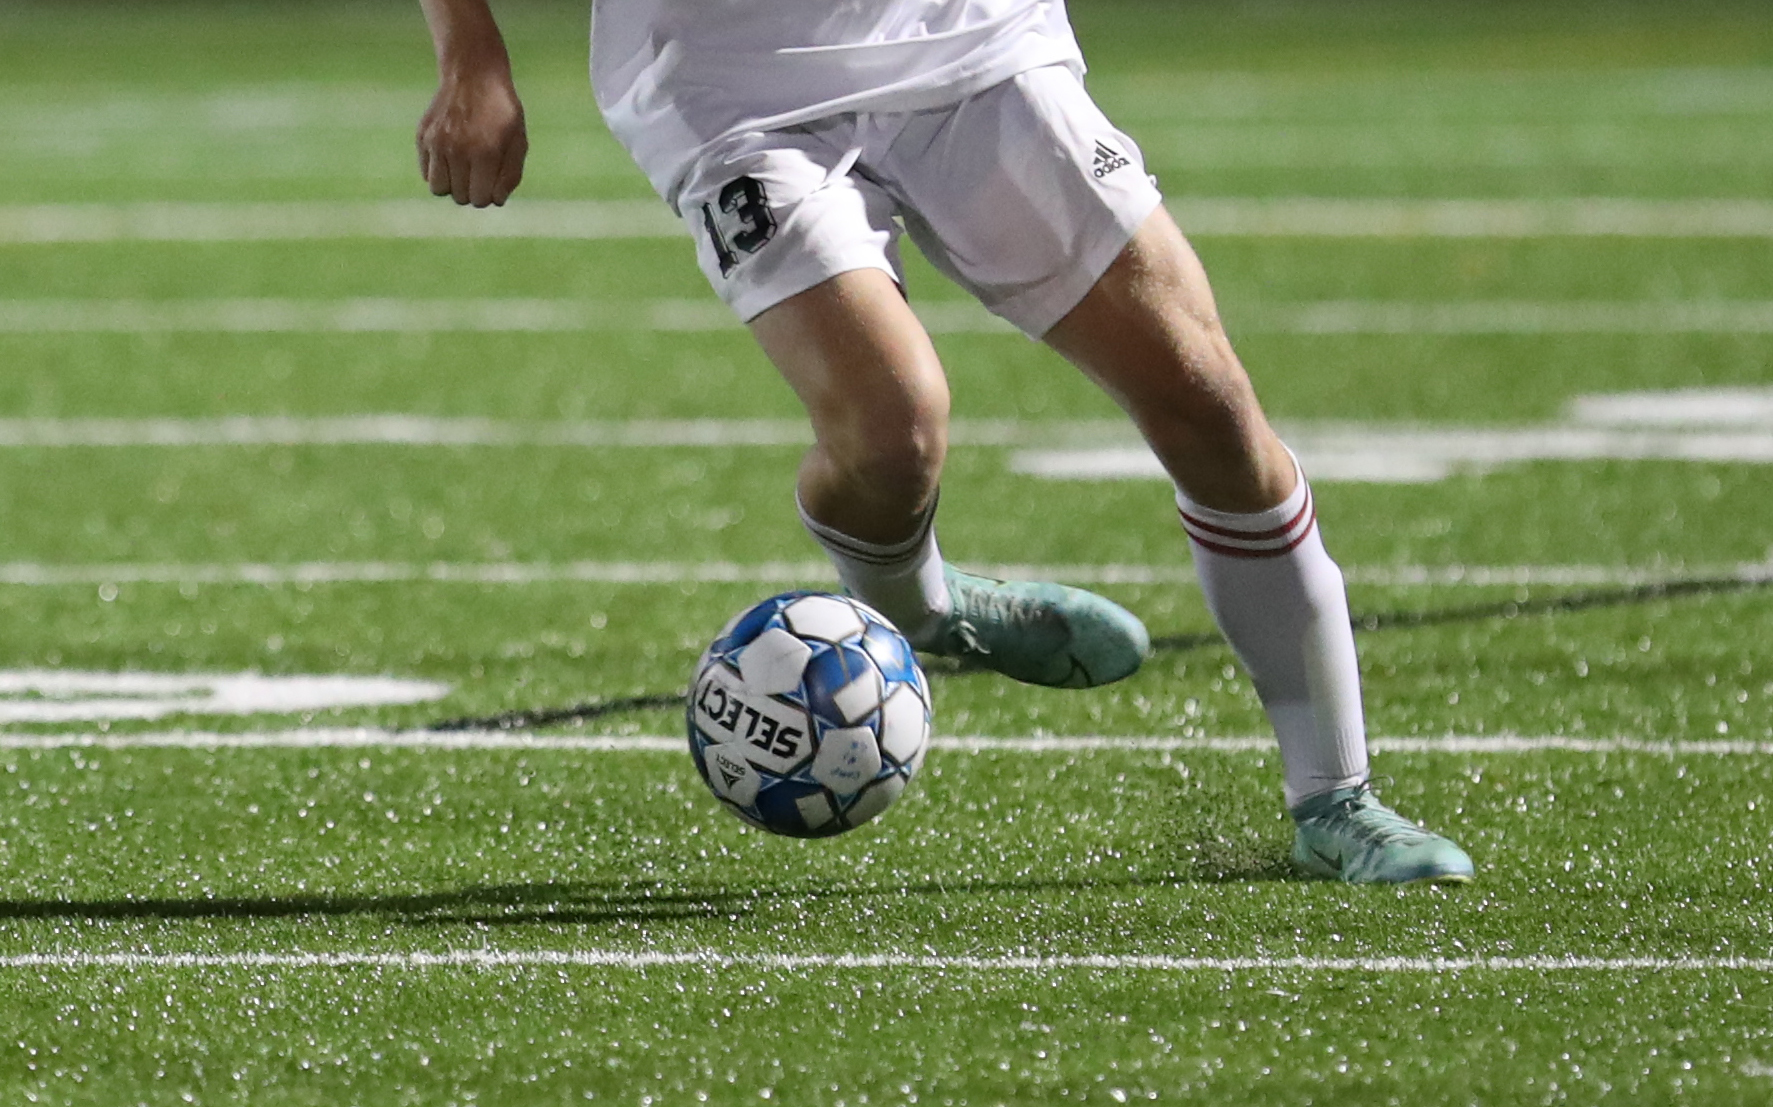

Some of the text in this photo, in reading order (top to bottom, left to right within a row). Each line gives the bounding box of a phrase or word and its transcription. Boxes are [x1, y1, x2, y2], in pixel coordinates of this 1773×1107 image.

[1093, 157, 1130, 178] adida
[702, 175, 777, 279] 13
[699, 680, 802, 758] SELECT
[717, 754, 746, 776] SELECT
